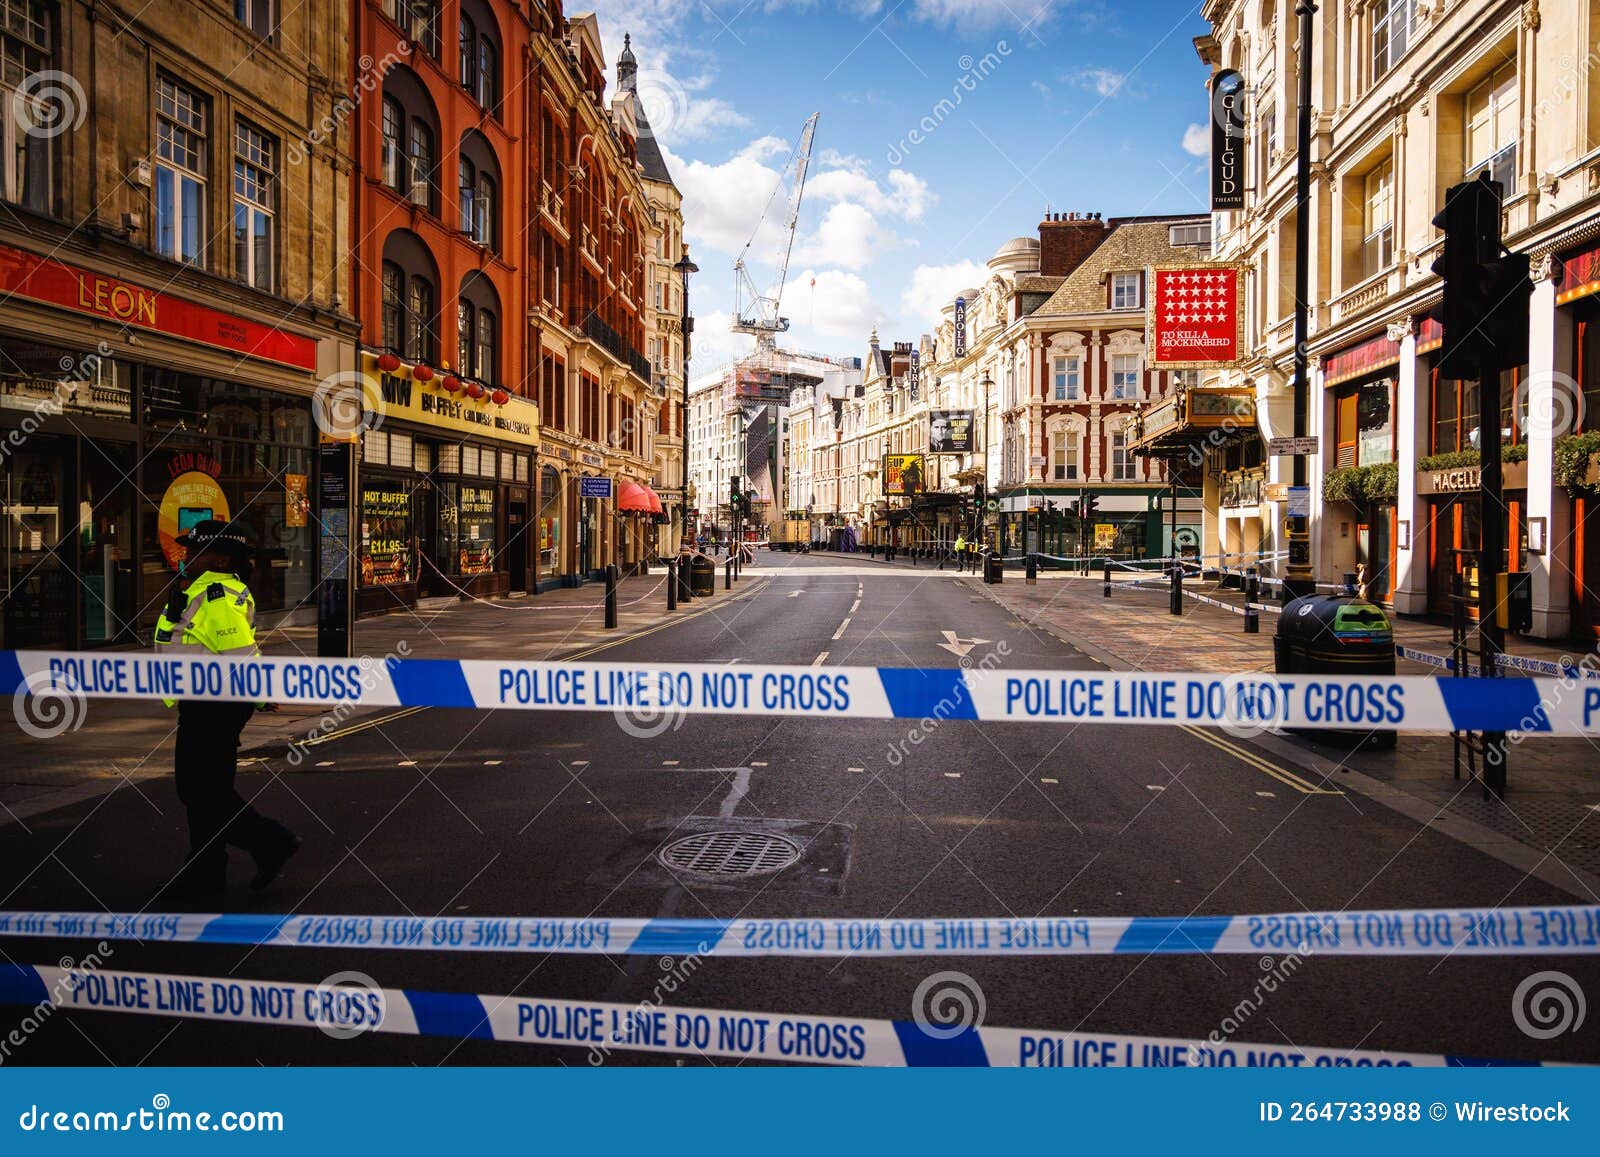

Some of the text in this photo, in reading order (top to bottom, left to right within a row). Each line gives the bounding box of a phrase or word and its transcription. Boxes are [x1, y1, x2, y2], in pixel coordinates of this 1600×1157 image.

[1222, 95, 1235, 194] GIELGUD
[1215, 195, 1242, 203] THEATRE
[78, 274, 156, 325] LEON
[956, 306, 965, 355] APOLLO
[1161, 330, 1209, 339] TO KILL A
[1161, 338, 1230, 347] MOCKINGBIRD
[422, 393, 461, 419] BUFFET
[168, 453, 194, 478] LEON
[893, 458, 904, 467] UP
[364, 491, 409, 504] HOT BUFFET
[462, 488, 493, 503] MR WU
[462, 504, 493, 512] HOT BUFFET
[371, 540, 400, 553] £11.95
[216, 627, 237, 637] POLICE
[50, 658, 362, 700] POLICE LINE DO NOT CROSS
[499, 669, 850, 711] POLICE LINE DO NOT CROSS
[1006, 678, 1405, 724] POLICE LINE DO NOT CROSS
[70, 973, 381, 1026] POLICE LINE DO NOT CROSS
[518, 1003, 865, 1060] POLICE LINE DO NOT CROSS
[1020, 1036, 1117, 1067] POLICE
